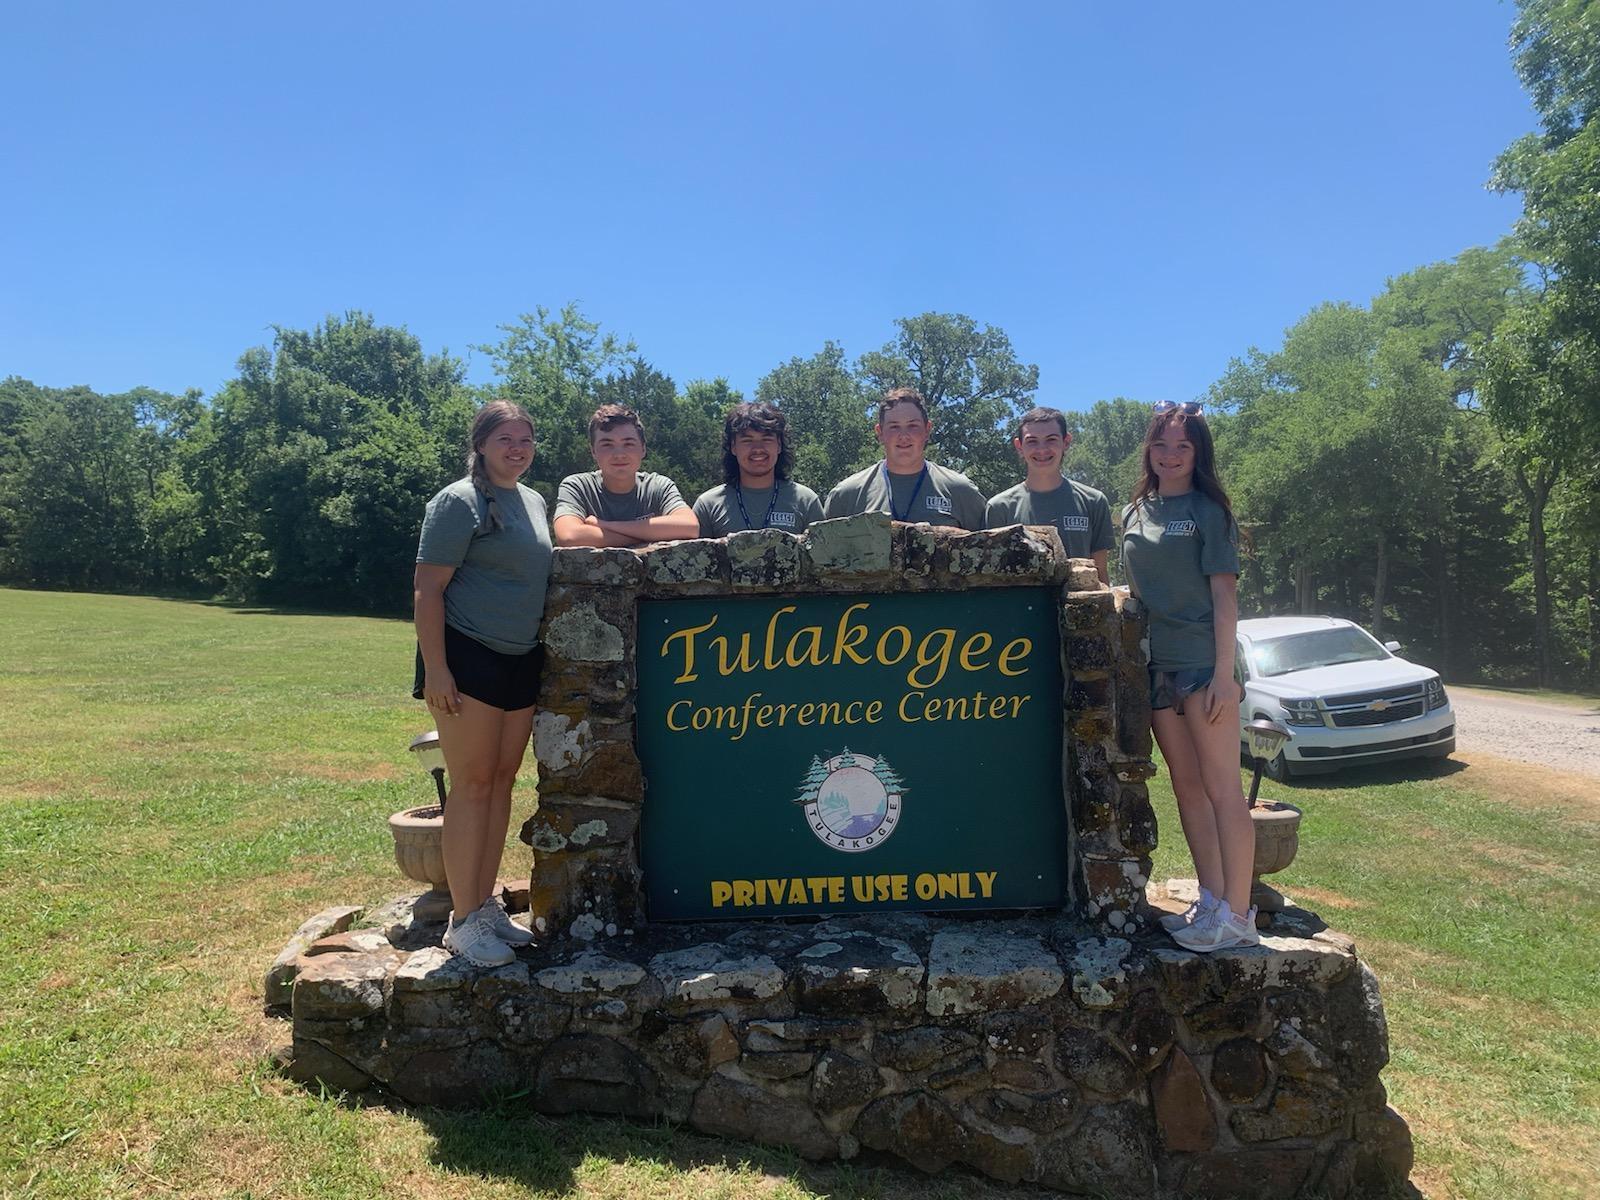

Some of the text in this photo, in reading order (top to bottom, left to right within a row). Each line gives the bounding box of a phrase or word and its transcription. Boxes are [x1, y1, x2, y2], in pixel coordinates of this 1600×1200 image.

[661, 603, 1034, 689] Tulakogee
[665, 691, 1031, 741] Conference Center
[809, 803, 898, 849] TULAKOGEE
[710, 871, 998, 908] PRIVATE USE ONLY
